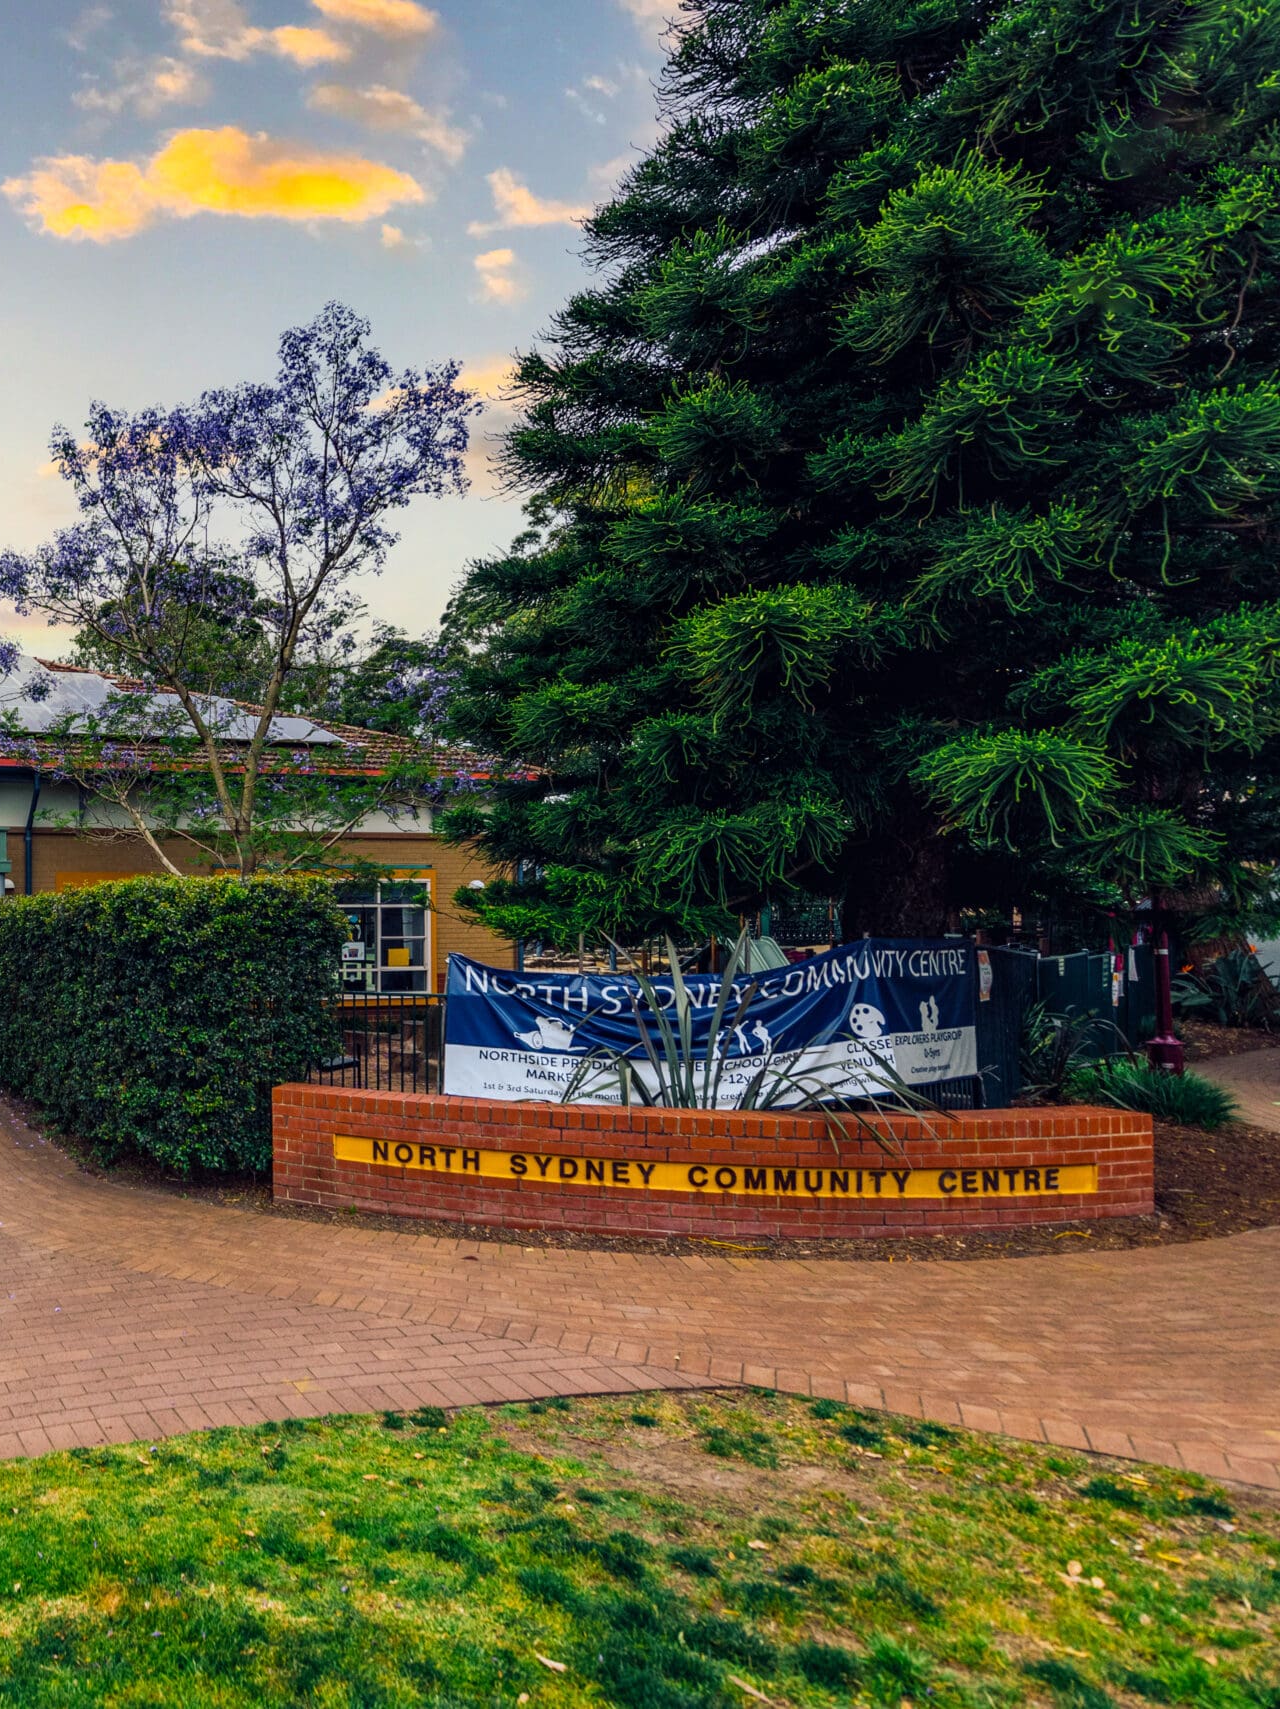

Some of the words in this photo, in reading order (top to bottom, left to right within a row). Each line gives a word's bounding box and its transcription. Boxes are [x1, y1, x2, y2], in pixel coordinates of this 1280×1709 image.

[909, 950, 966, 977] CENTRE
[846, 1038, 893, 1054] CLASSE
[479, 1050, 557, 1067] NORTHSIDE
[721, 1057, 768, 1071] CHOOL
[526, 1069, 576, 1083] MARKE
[483, 1082, 495, 1090] 1st
[506, 1084, 522, 1093] 3rd
[524, 1085, 563, 1098] Saturday
[372, 1141, 481, 1171] NORTH
[510, 1154, 656, 1184] SYDNEY
[687, 1166, 911, 1194] COMMUNITY
[938, 1167, 1060, 1193] CENTRE
